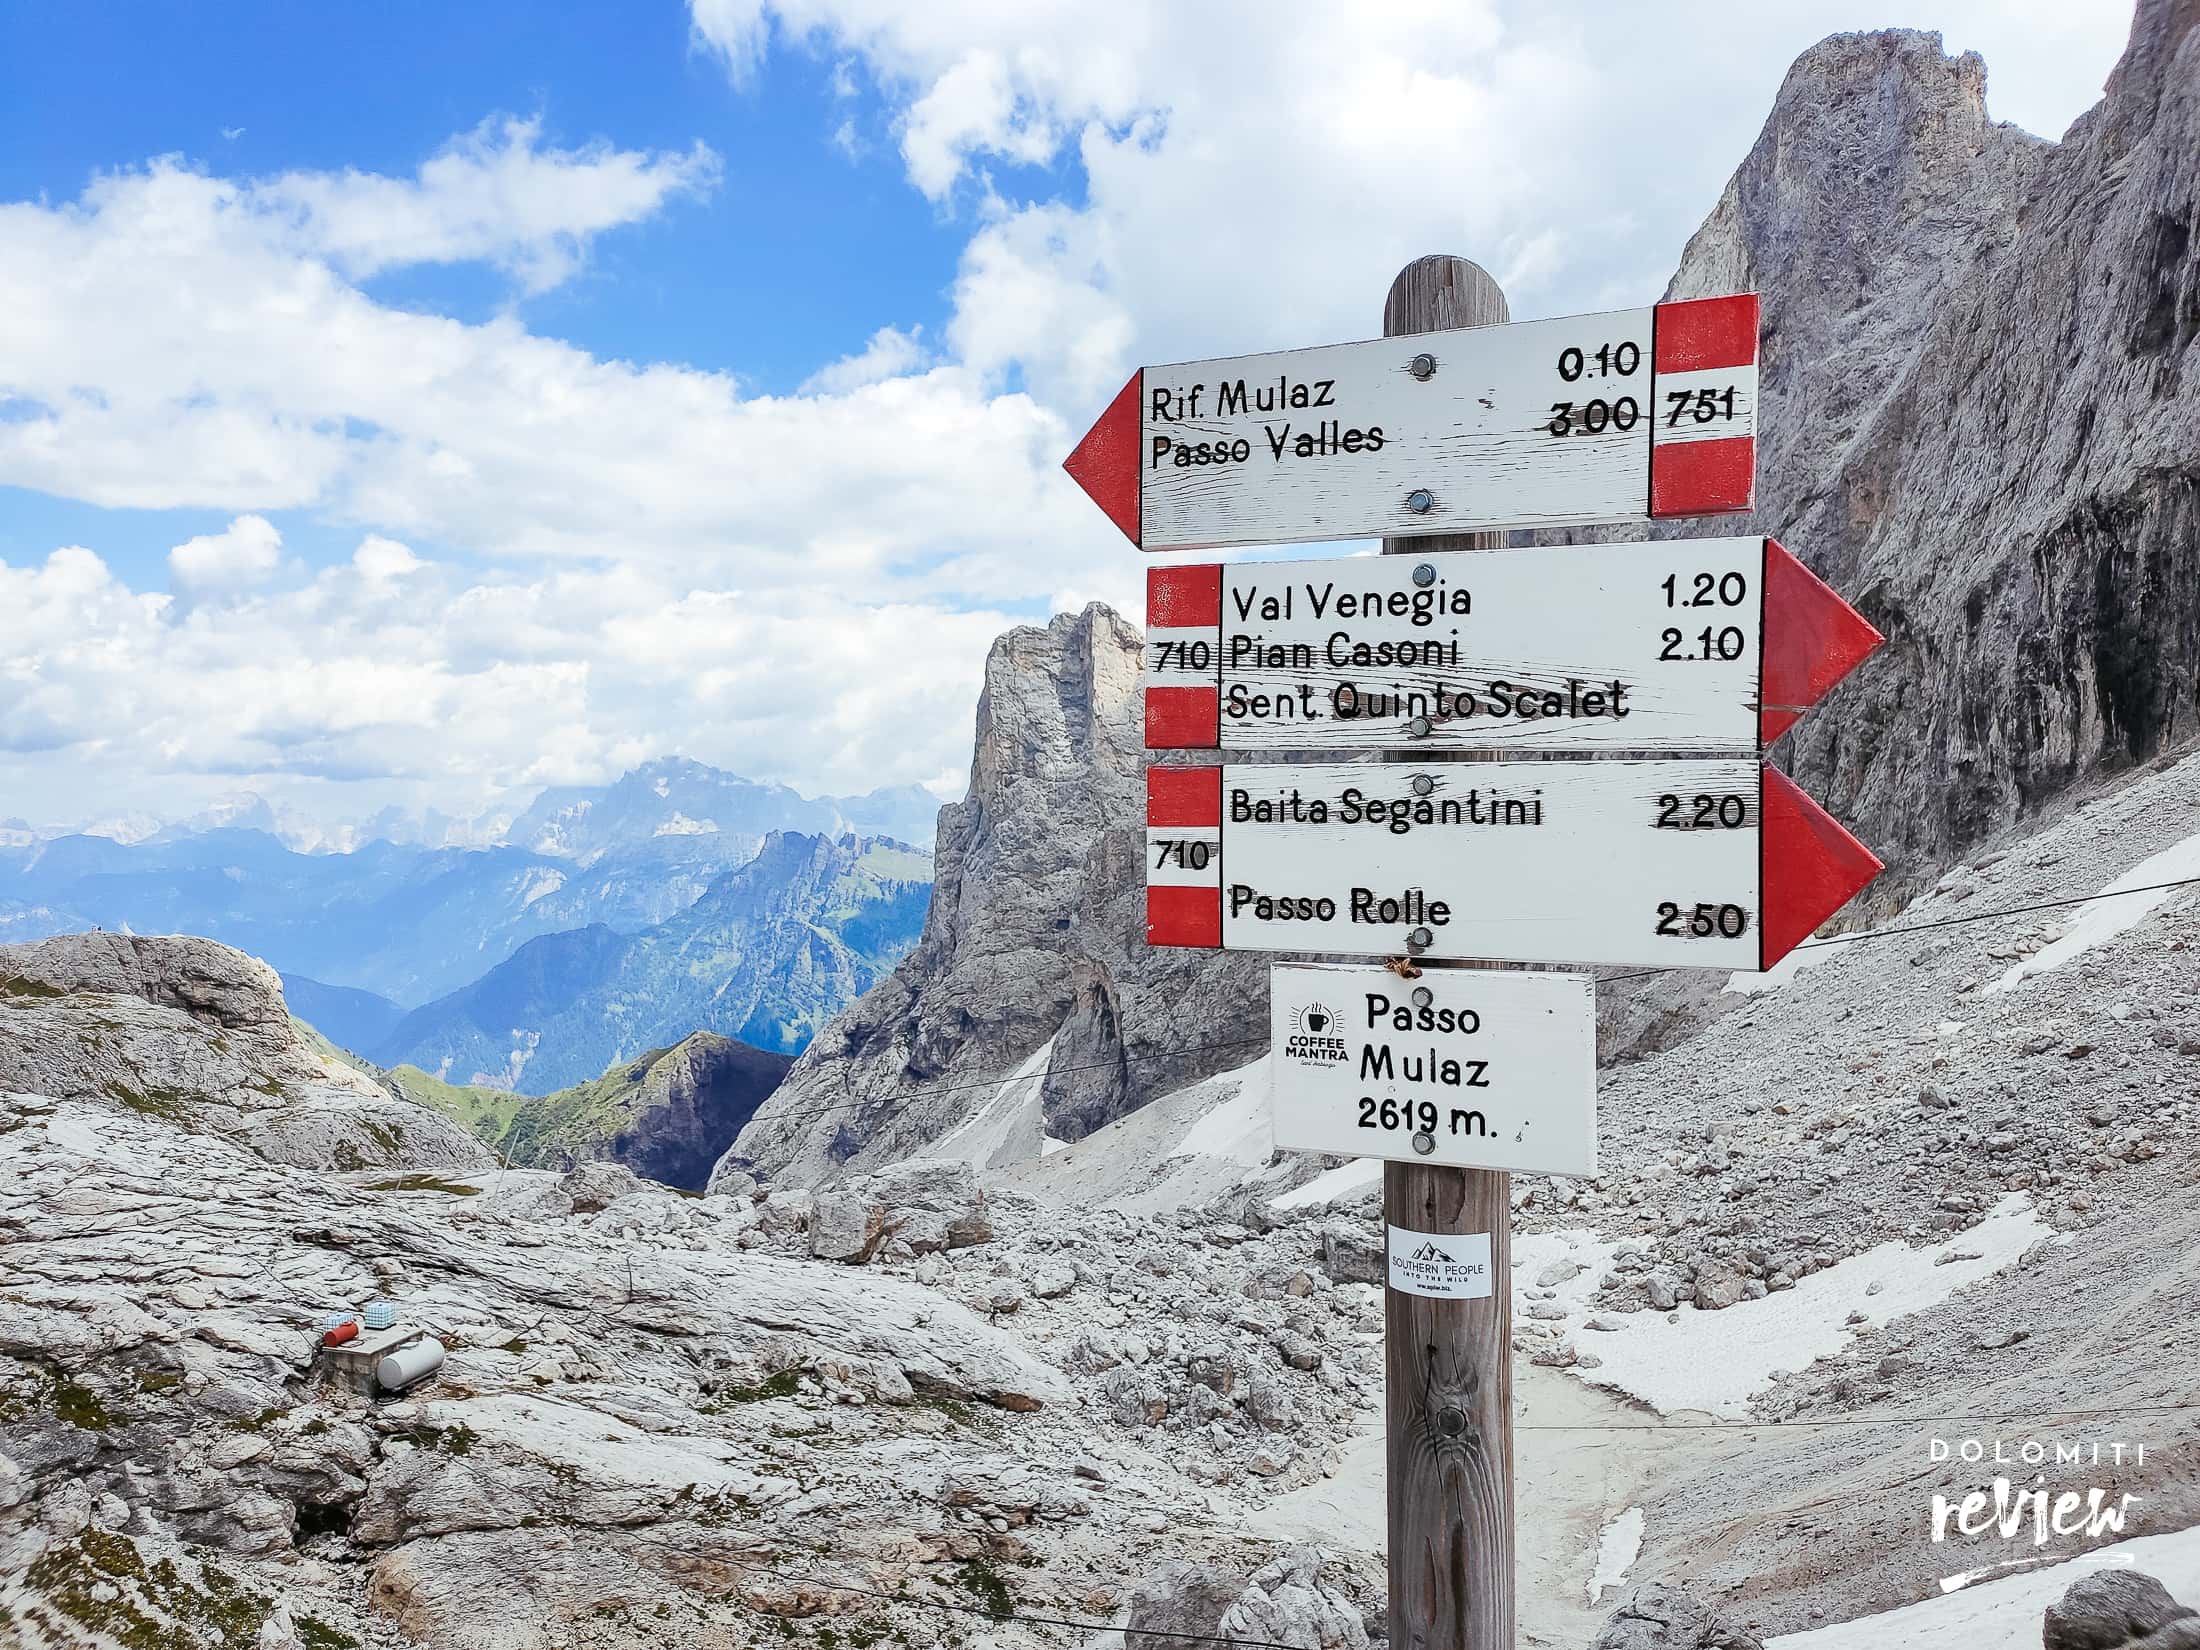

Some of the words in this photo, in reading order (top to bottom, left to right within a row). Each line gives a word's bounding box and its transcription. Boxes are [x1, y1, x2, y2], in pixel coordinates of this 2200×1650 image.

[1152, 384, 1205, 422] Rif.
[1216, 375, 1336, 417] Mulaz
[1558, 341, 1640, 382] 0.10
[1667, 385, 1735, 428] 751
[1152, 436, 1251, 470] Passo
[1264, 420, 1384, 463] Valles
[1231, 585, 1292, 623] Val
[1306, 582, 1473, 627] Venegia
[1661, 571, 1747, 608] 1.20
[1156, 640, 1210, 672] 710
[1231, 634, 1311, 669] Pian
[1326, 629, 1460, 668] Casoni
[1659, 625, 1745, 661] 2.10
[1226, 684, 1324, 719] Sent.
[1333, 681, 1477, 719] Quinto
[1489, 679, 1631, 718] Scalet
[1231, 788, 1328, 824] Baita
[1340, 788, 1543, 835] Segantini
[1657, 794, 1746, 829] 2.20
[1155, 840, 1210, 870] 710
[1230, 885, 1337, 922] Passo
[1351, 887, 1452, 927] Rolle
[1365, 993, 1481, 1035] Passo
[1285, 1046, 1350, 1062] MANTRA
[1289, 1035, 1345, 1050] COFFEE
[1360, 1043, 1490, 1088] Mulaz
[1358, 1096, 1438, 1134] 2619
[1451, 1107, 1498, 1139] m.
[1392, 1255, 1439, 1275] SOUTHERN
[1445, 1264, 1484, 1276] PEOPLE
